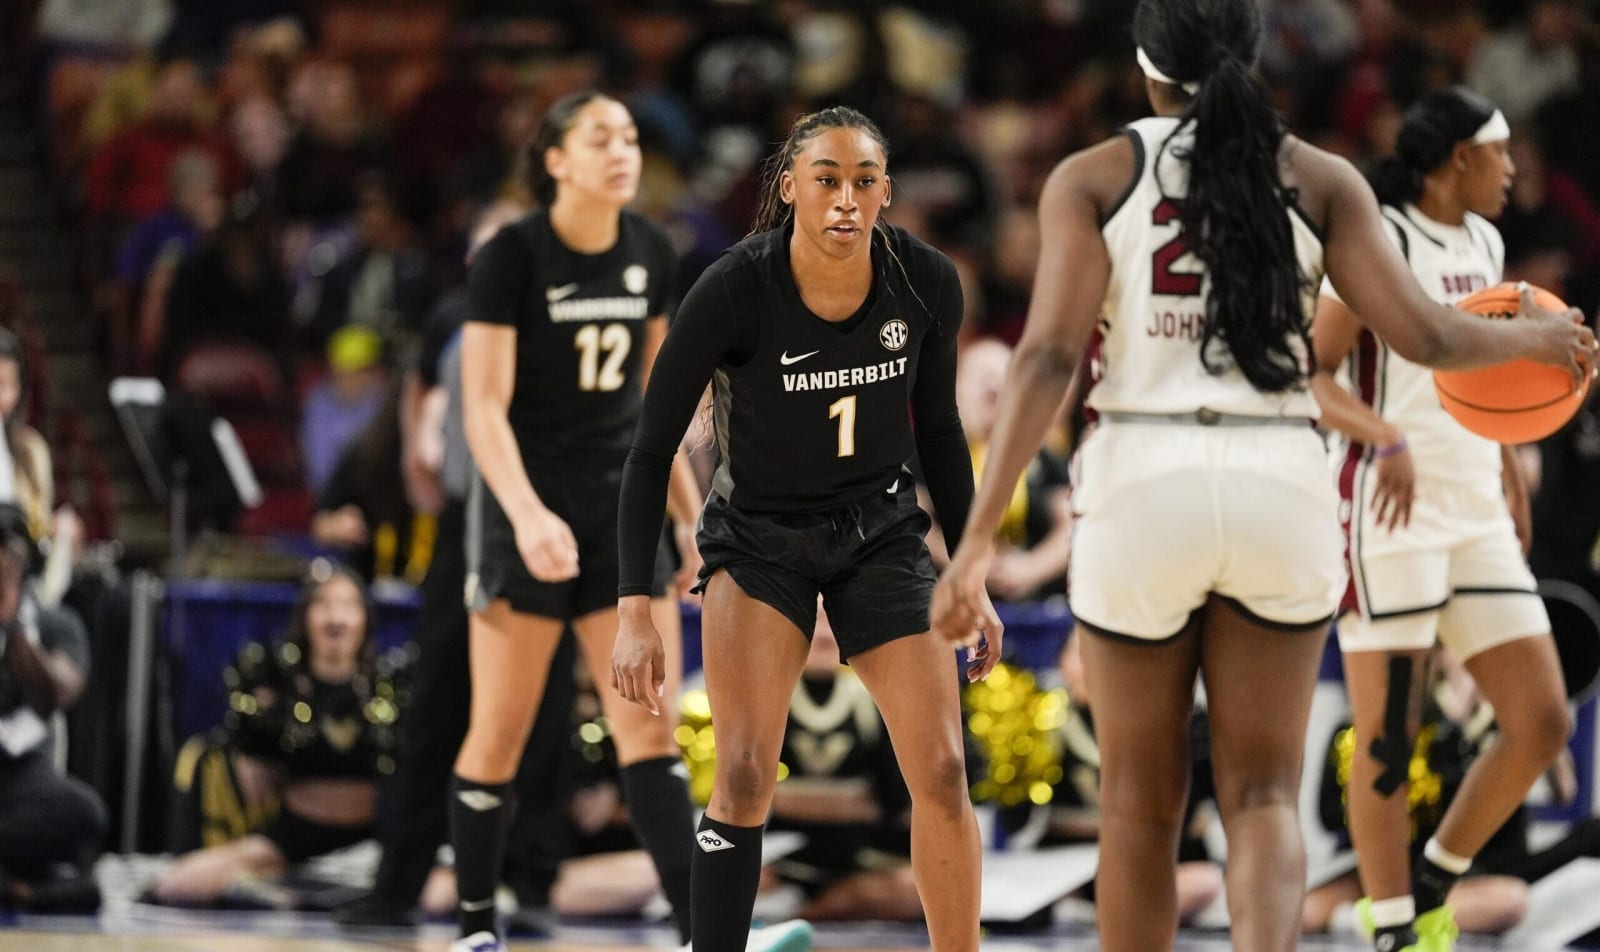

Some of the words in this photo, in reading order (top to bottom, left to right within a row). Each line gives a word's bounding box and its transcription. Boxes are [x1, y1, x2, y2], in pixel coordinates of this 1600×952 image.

[574, 323, 632, 391] 12
[881, 320, 907, 349] SEC
[782, 356, 908, 392] VANDERBILT
[828, 394, 857, 458] 1
